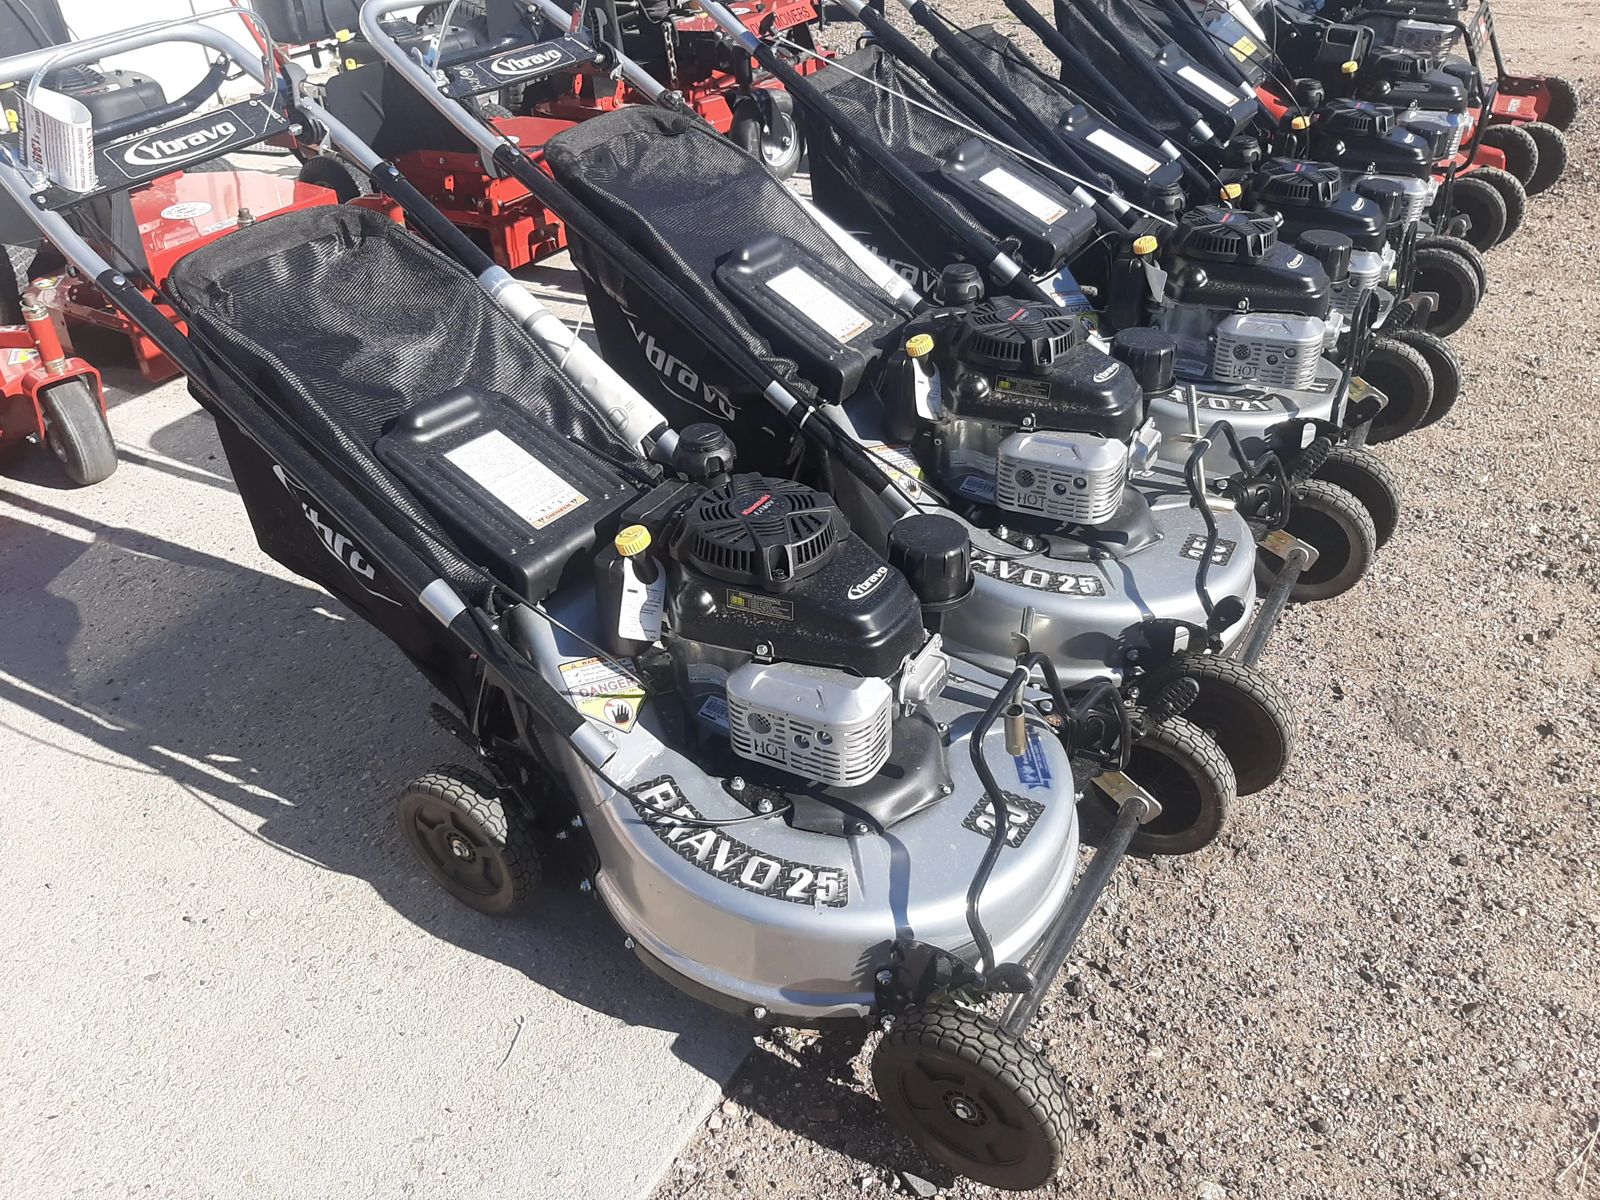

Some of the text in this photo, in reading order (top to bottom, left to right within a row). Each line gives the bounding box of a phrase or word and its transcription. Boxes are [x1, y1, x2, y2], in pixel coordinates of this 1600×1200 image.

[775, 6, 811, 29] MOWERS
[498, 49, 563, 72] Ybravo
[136, 121, 238, 160] Ybravo
[1232, 365, 1261, 378] HOT
[1016, 491, 1047, 508] HOT
[850, 566, 889, 595] Ybravo
[970, 547, 1097, 594] AVO 25
[578, 677, 638, 698] DANGER
[753, 737, 789, 761] HOT
[636, 780, 840, 901] BRAVO 25
